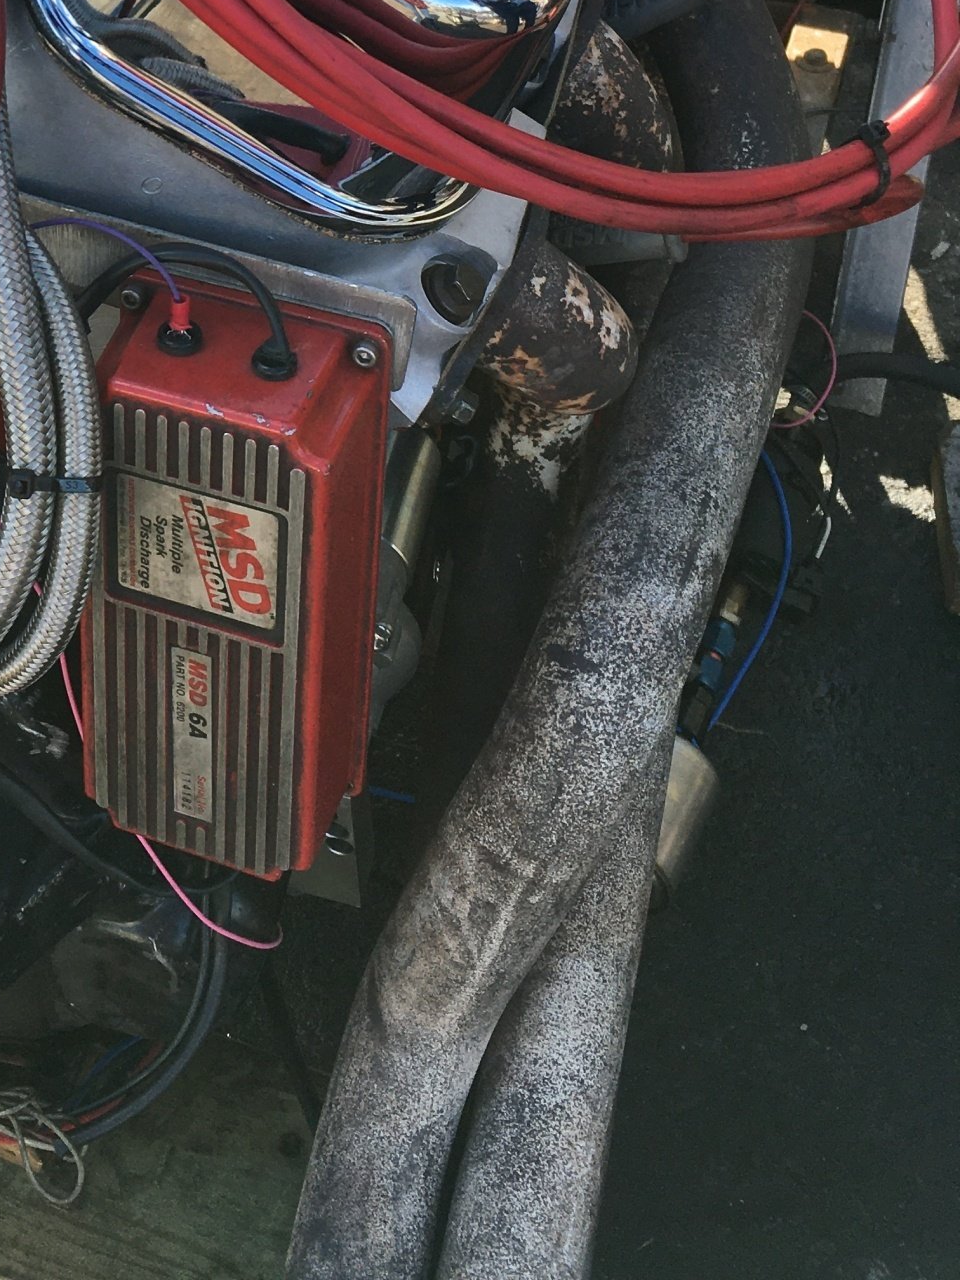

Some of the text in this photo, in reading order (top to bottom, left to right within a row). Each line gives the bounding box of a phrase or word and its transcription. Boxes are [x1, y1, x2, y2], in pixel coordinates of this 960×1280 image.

[139, 515, 153, 589] Discharge
[155, 515, 168, 557] Spark
[171, 515, 185, 574] Multiple
[190, 501, 230, 611] IGNITION
[207, 504, 275, 617] MSD
[175, 655, 186, 677] PART
[187, 659, 208, 739] MSD 6A
[176, 701, 186, 722] 6200
